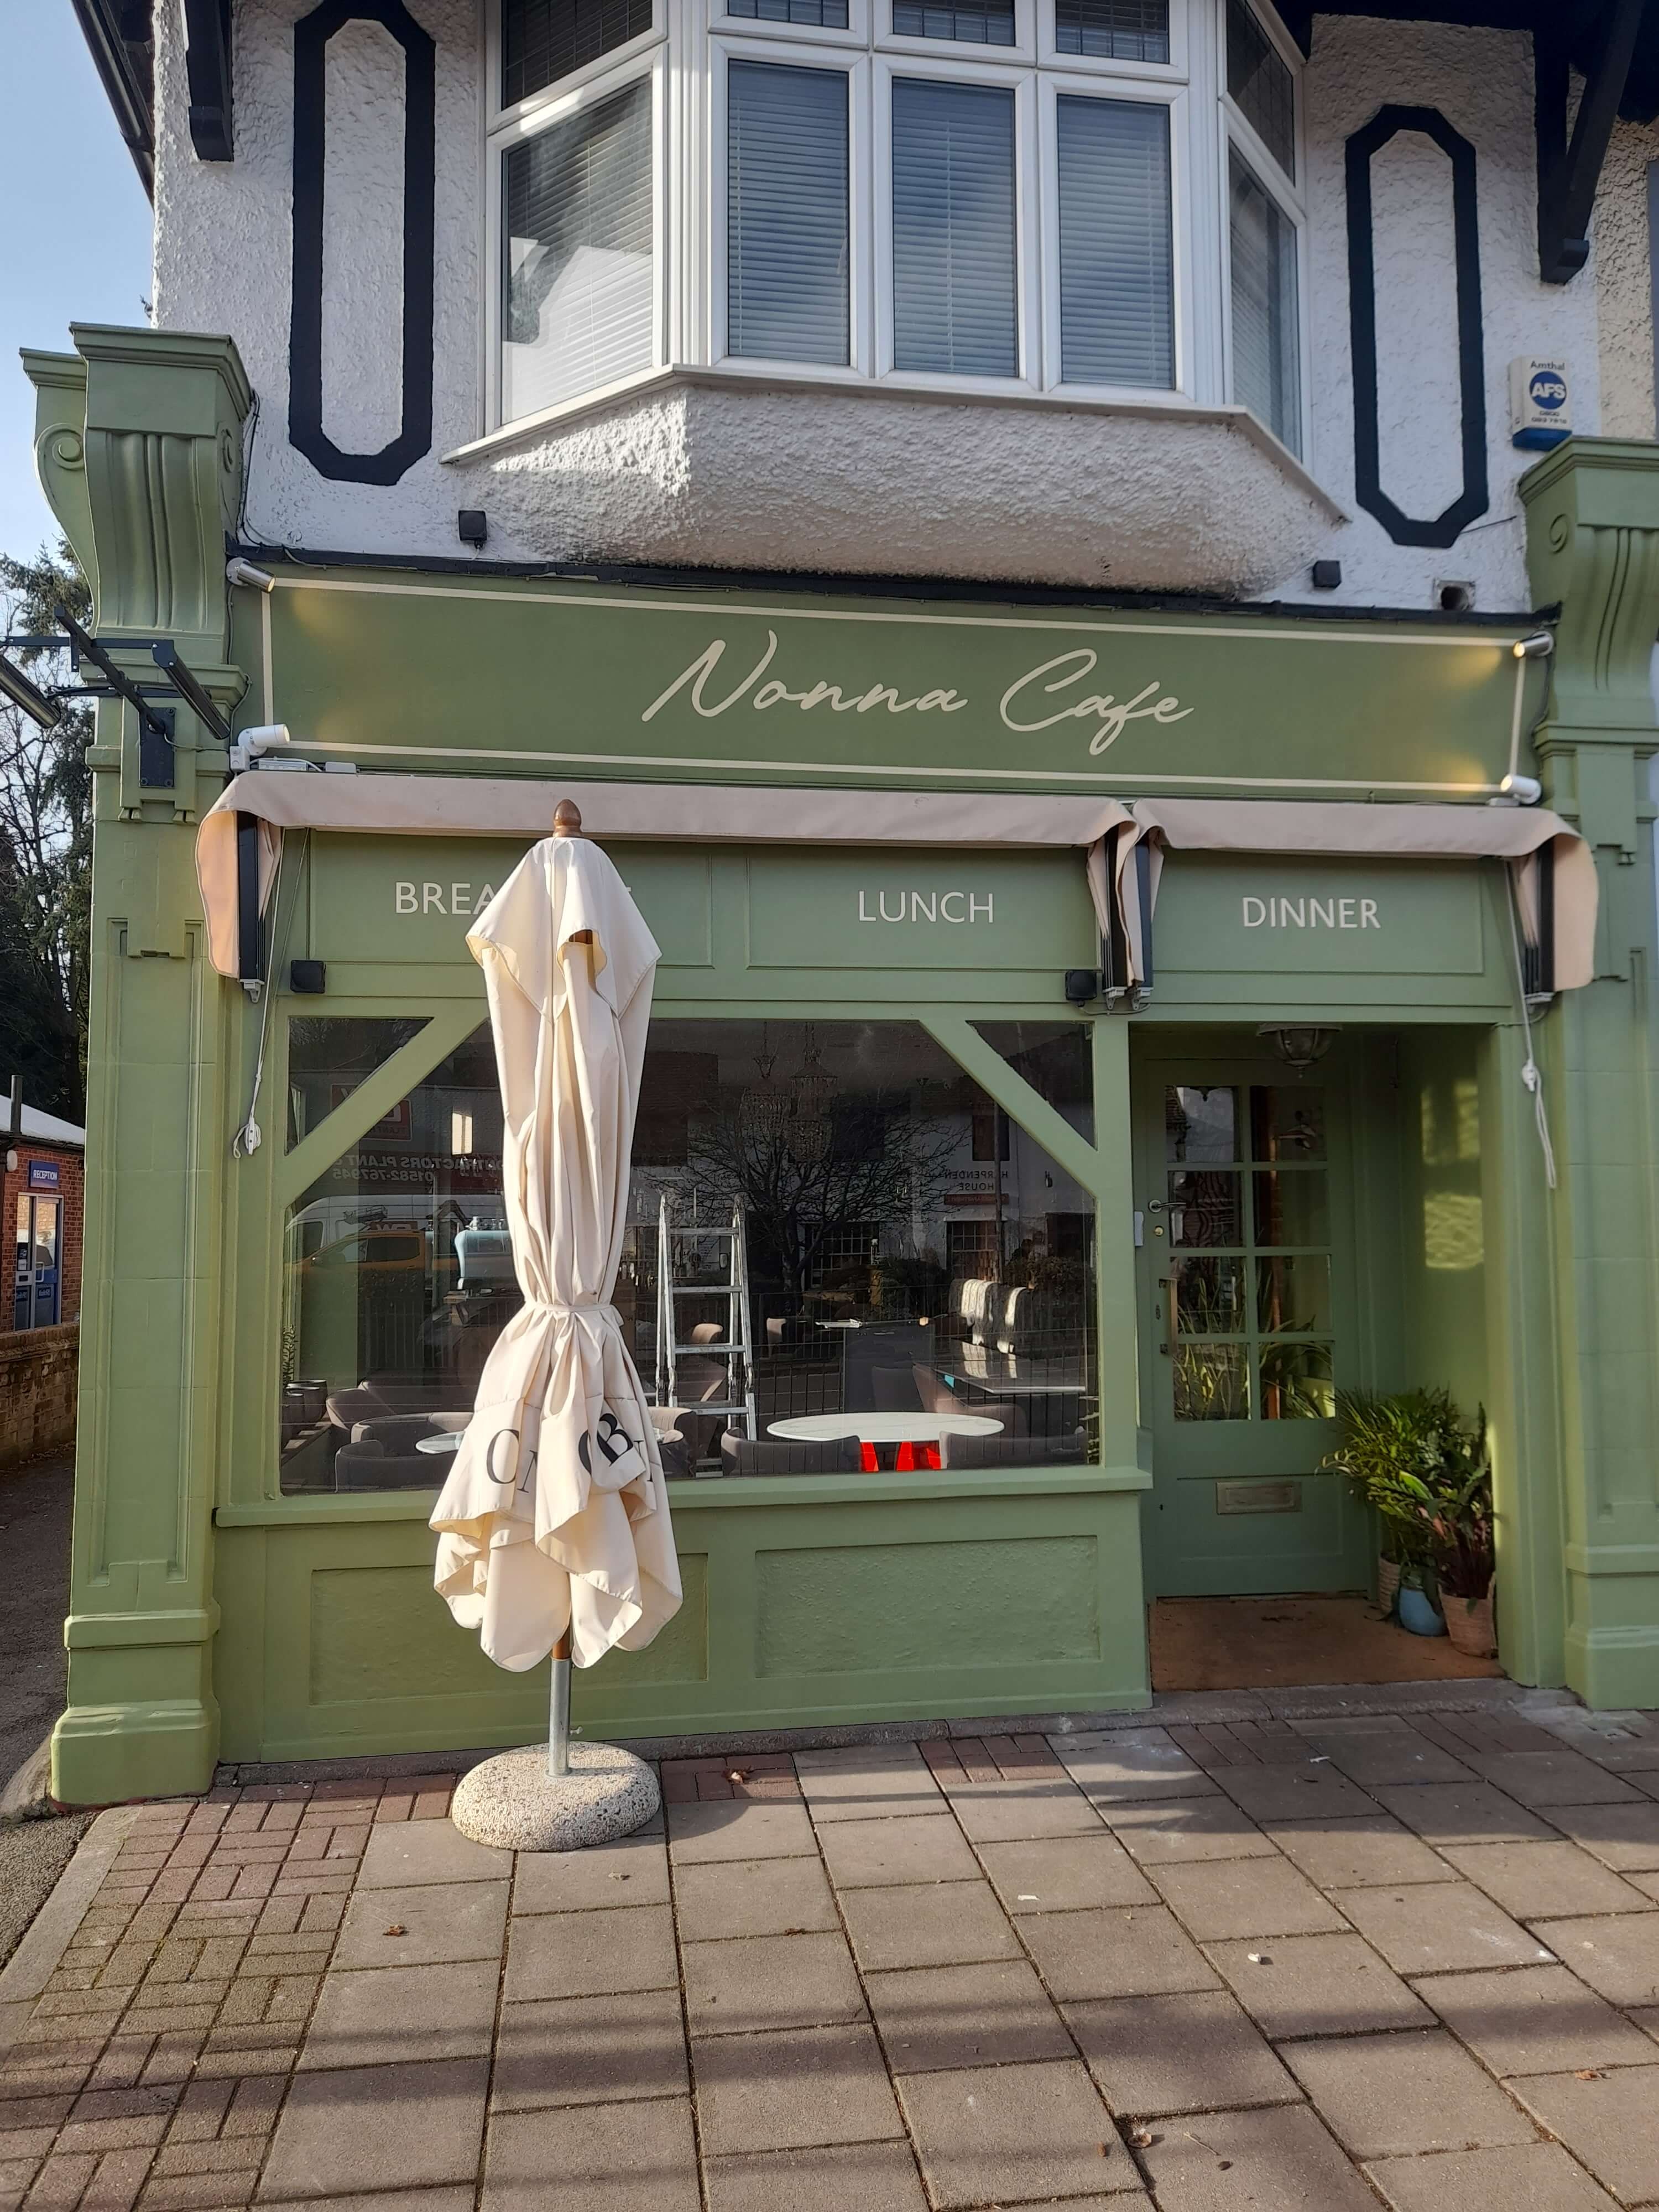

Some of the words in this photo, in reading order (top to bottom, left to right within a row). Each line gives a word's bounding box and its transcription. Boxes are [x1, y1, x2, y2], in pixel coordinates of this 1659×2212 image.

[1530, 360, 1566, 371] Amthal
[1531, 382, 1566, 399] AFS
[641, 629, 968, 722] Nonna
[1000, 648, 1194, 755] Cafe
[858, 890, 994, 924] LUNCH
[1243, 896, 1381, 929] DINNER
[33, 1169, 58, 1180] RECEPTION
